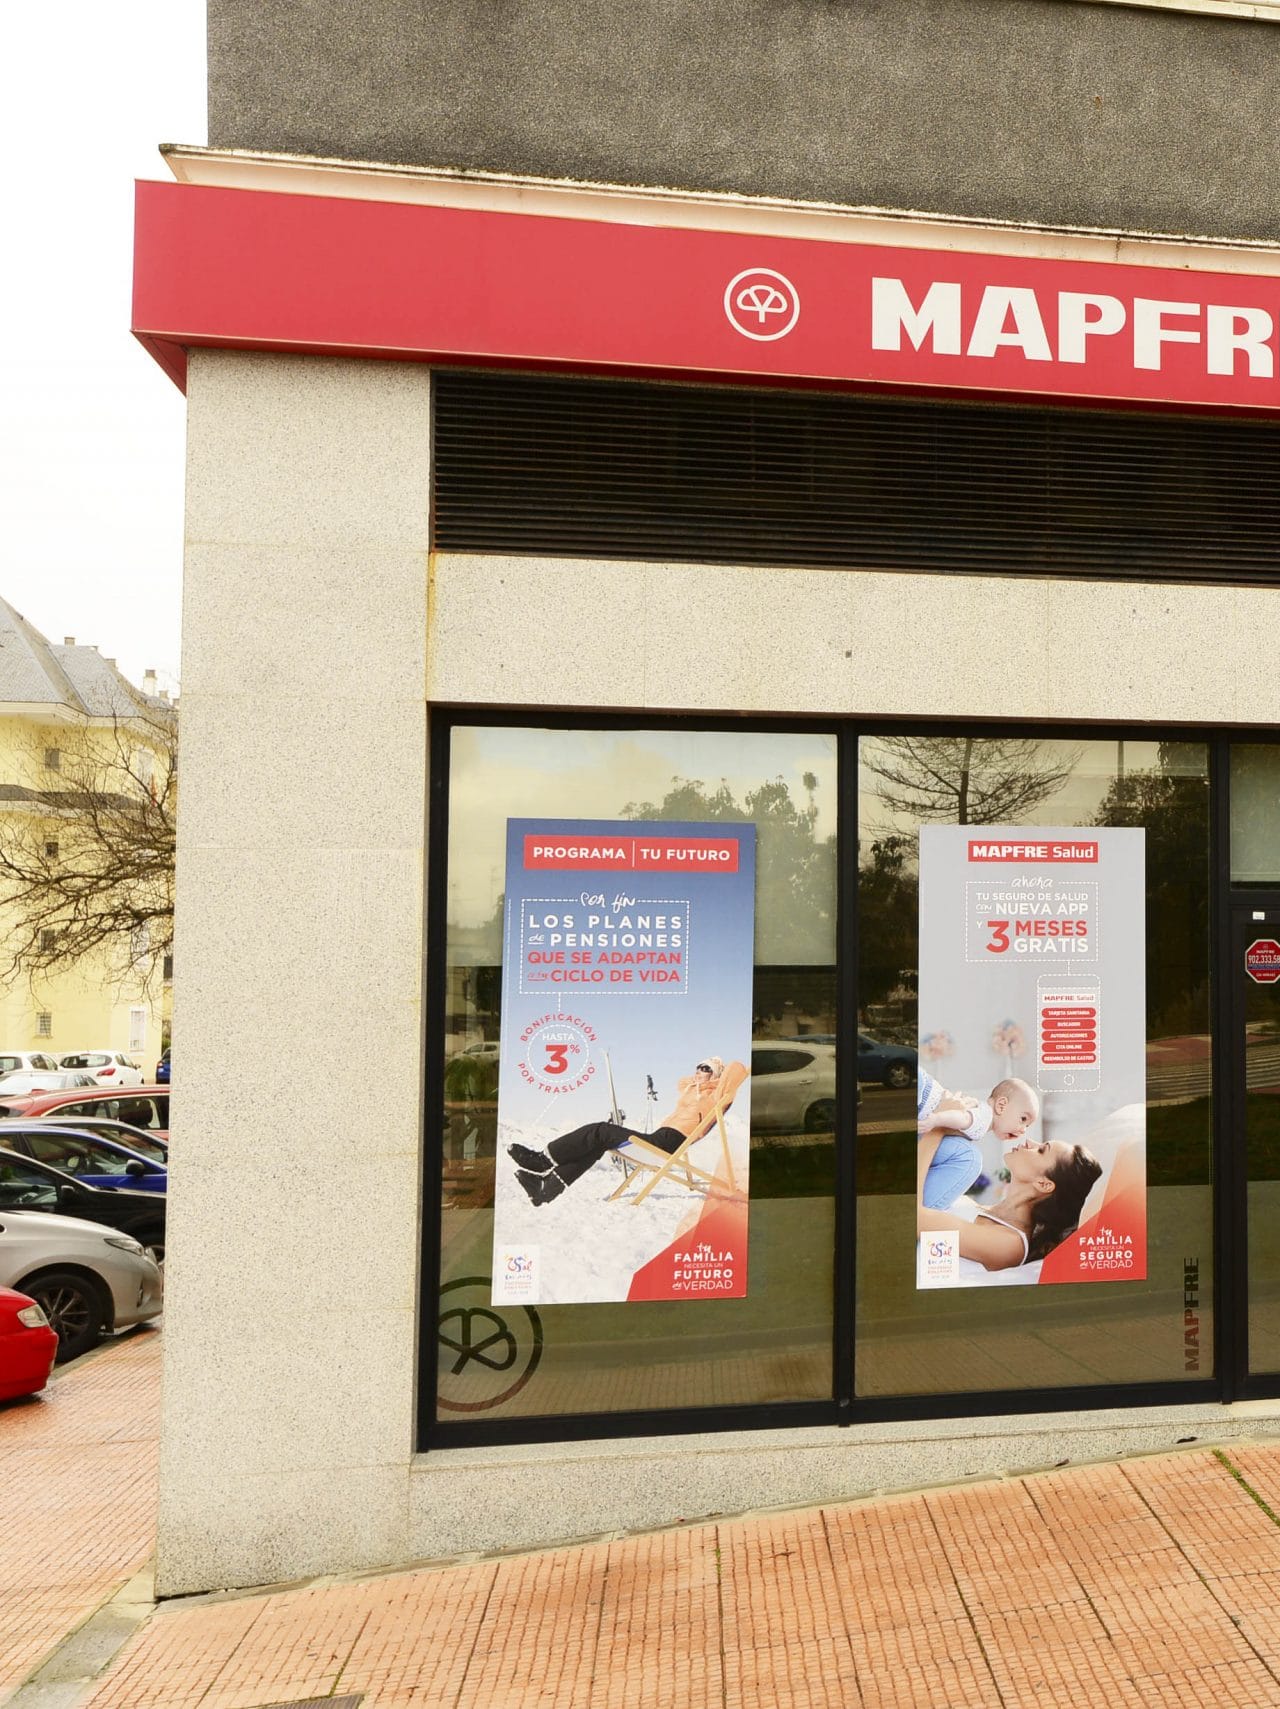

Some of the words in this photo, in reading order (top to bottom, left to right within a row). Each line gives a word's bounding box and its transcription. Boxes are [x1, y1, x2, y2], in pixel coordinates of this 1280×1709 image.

[533, 846, 626, 860] PROGRAMA
[640, 848, 661, 860] TU
[666, 849, 731, 861] FUTURO
[972, 845, 1048, 859] MAPFRE
[1052, 845, 1094, 859] Salud
[1011, 875, 1054, 889] ahora
[975, 892, 990, 901] TU
[992, 892, 1035, 901] SEGURO
[1038, 892, 1051, 901] DE
[1054, 892, 1089, 901] SALUD
[995, 902, 1052, 915] NUEVA
[1056, 902, 1089, 915] APP
[529, 914, 574, 929] LOS
[588, 915, 682, 929] PLANES
[550, 933, 682, 948] PENSIONES
[976, 920, 983, 929] Y
[986, 920, 1010, 953] 3
[1015, 920, 1088, 936] MESES
[1013, 937, 1089, 953] GRATIS
[527, 950, 565, 965] QUE
[571, 951, 593, 965] SE
[597, 951, 682, 965] ADAPTAN
[550, 969, 604, 983] CICLO
[609, 969, 633, 982] DE
[638, 969, 681, 982] VIDA
[542, 1033, 576, 1041] HASTA
[518, 1062, 535, 1084] POR
[1079, 1235, 1133, 1246] FAMILIA
[674, 1252, 734, 1263] FAMILIA
[1079, 1250, 1133, 1261] SEGURO
[1088, 1259, 1133, 1270] VERDAD
[674, 1269, 733, 1280] FUTURO
[682, 1279, 734, 1291] VERDAD
[1184, 1257, 1199, 1371] MAPFRE
